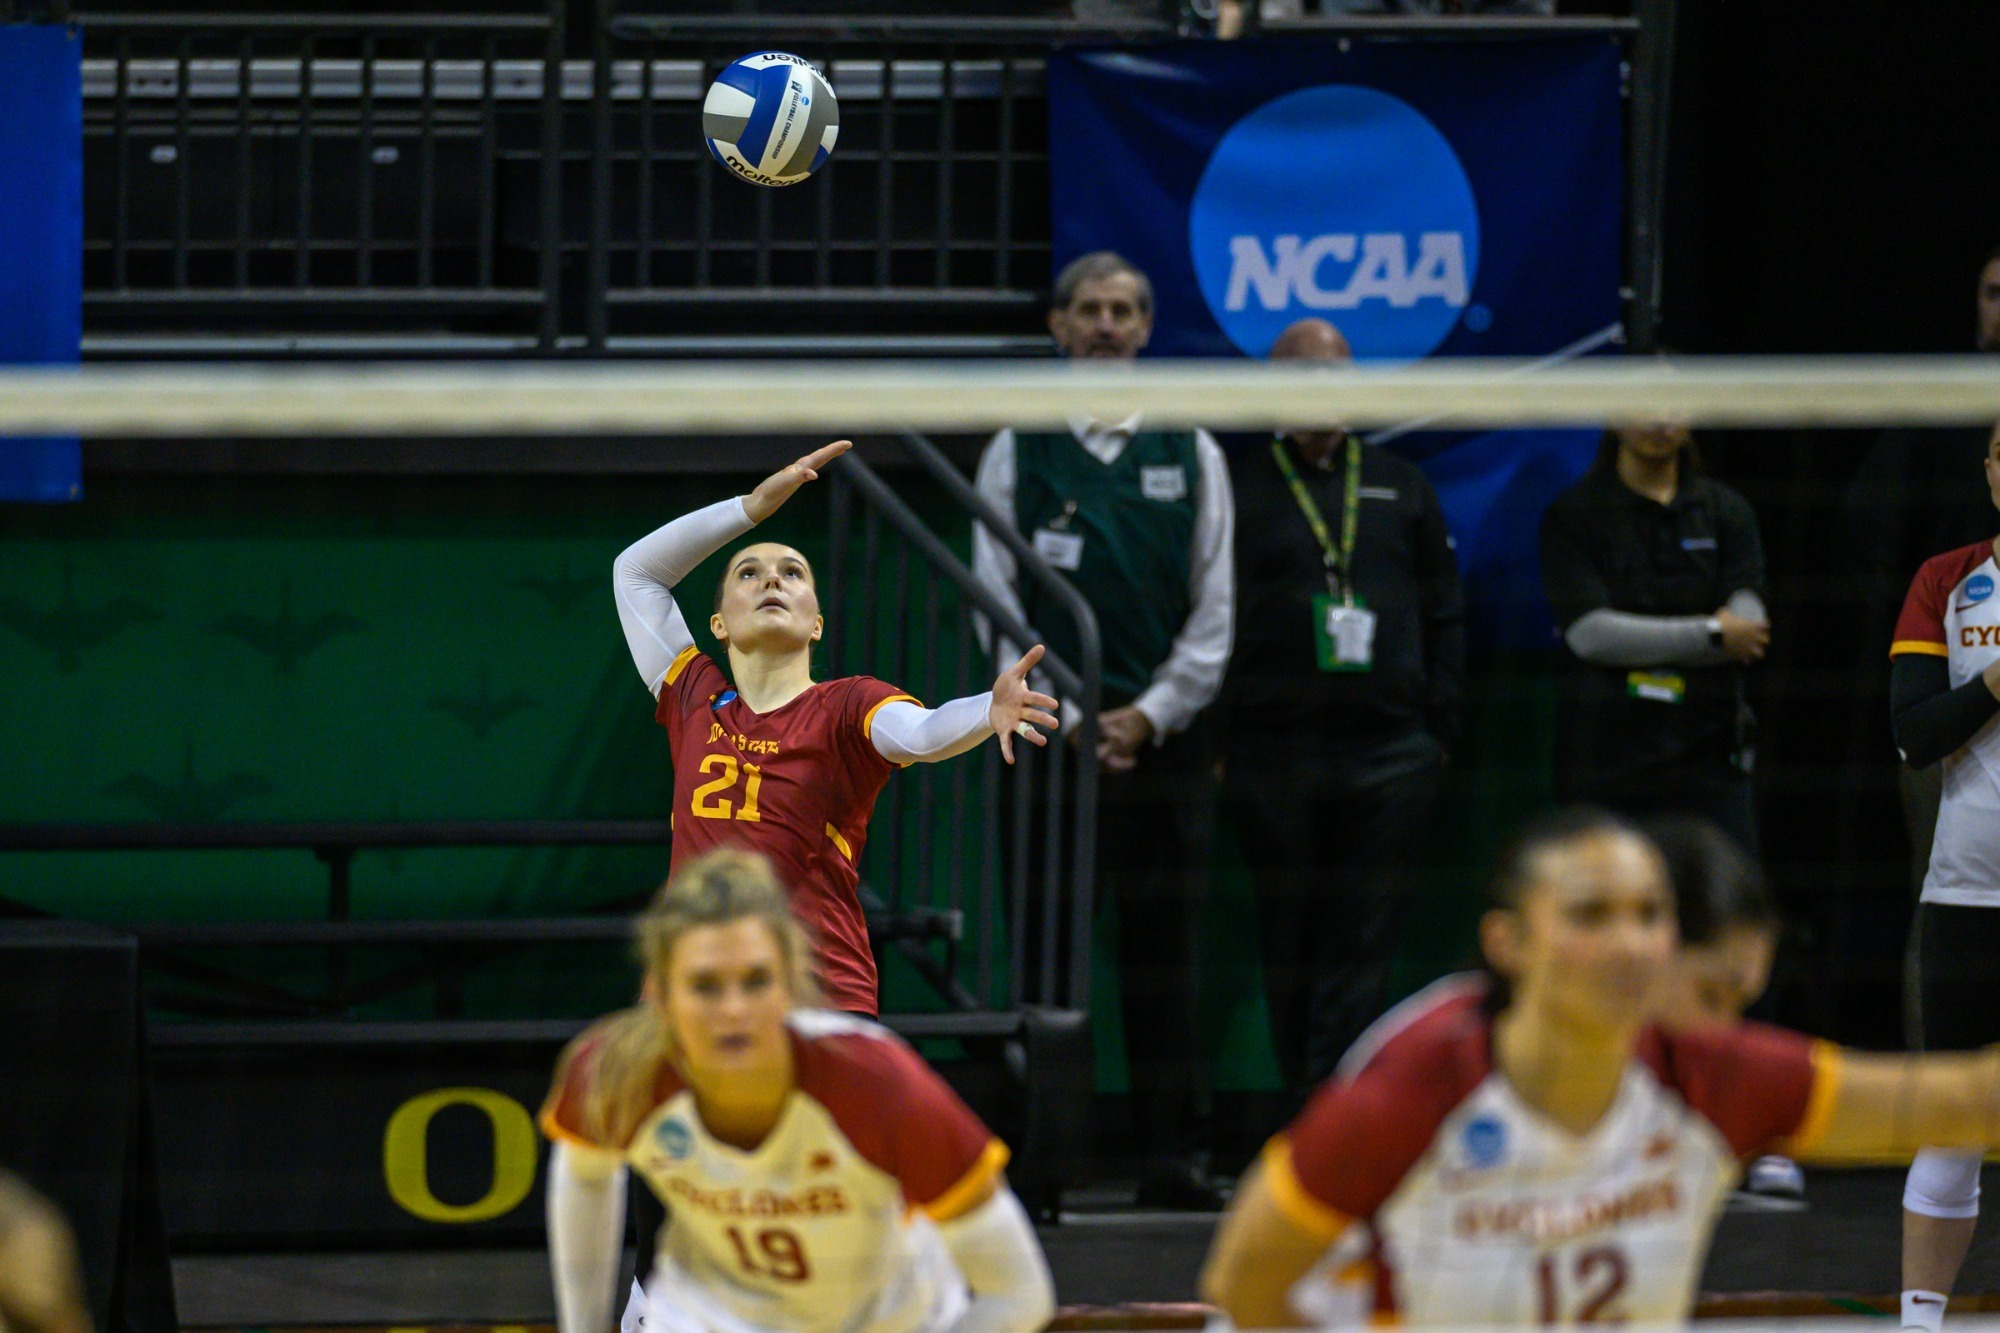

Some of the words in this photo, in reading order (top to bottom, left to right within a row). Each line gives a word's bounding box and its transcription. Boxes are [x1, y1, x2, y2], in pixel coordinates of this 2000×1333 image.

[725, 155, 795, 187] molten
[1223, 231, 1471, 311] NCAA
[691, 754, 762, 822] 21
[384, 1086, 538, 1223] O
[726, 1224, 812, 1285] 19
[1536, 1243, 1631, 1325] 12
